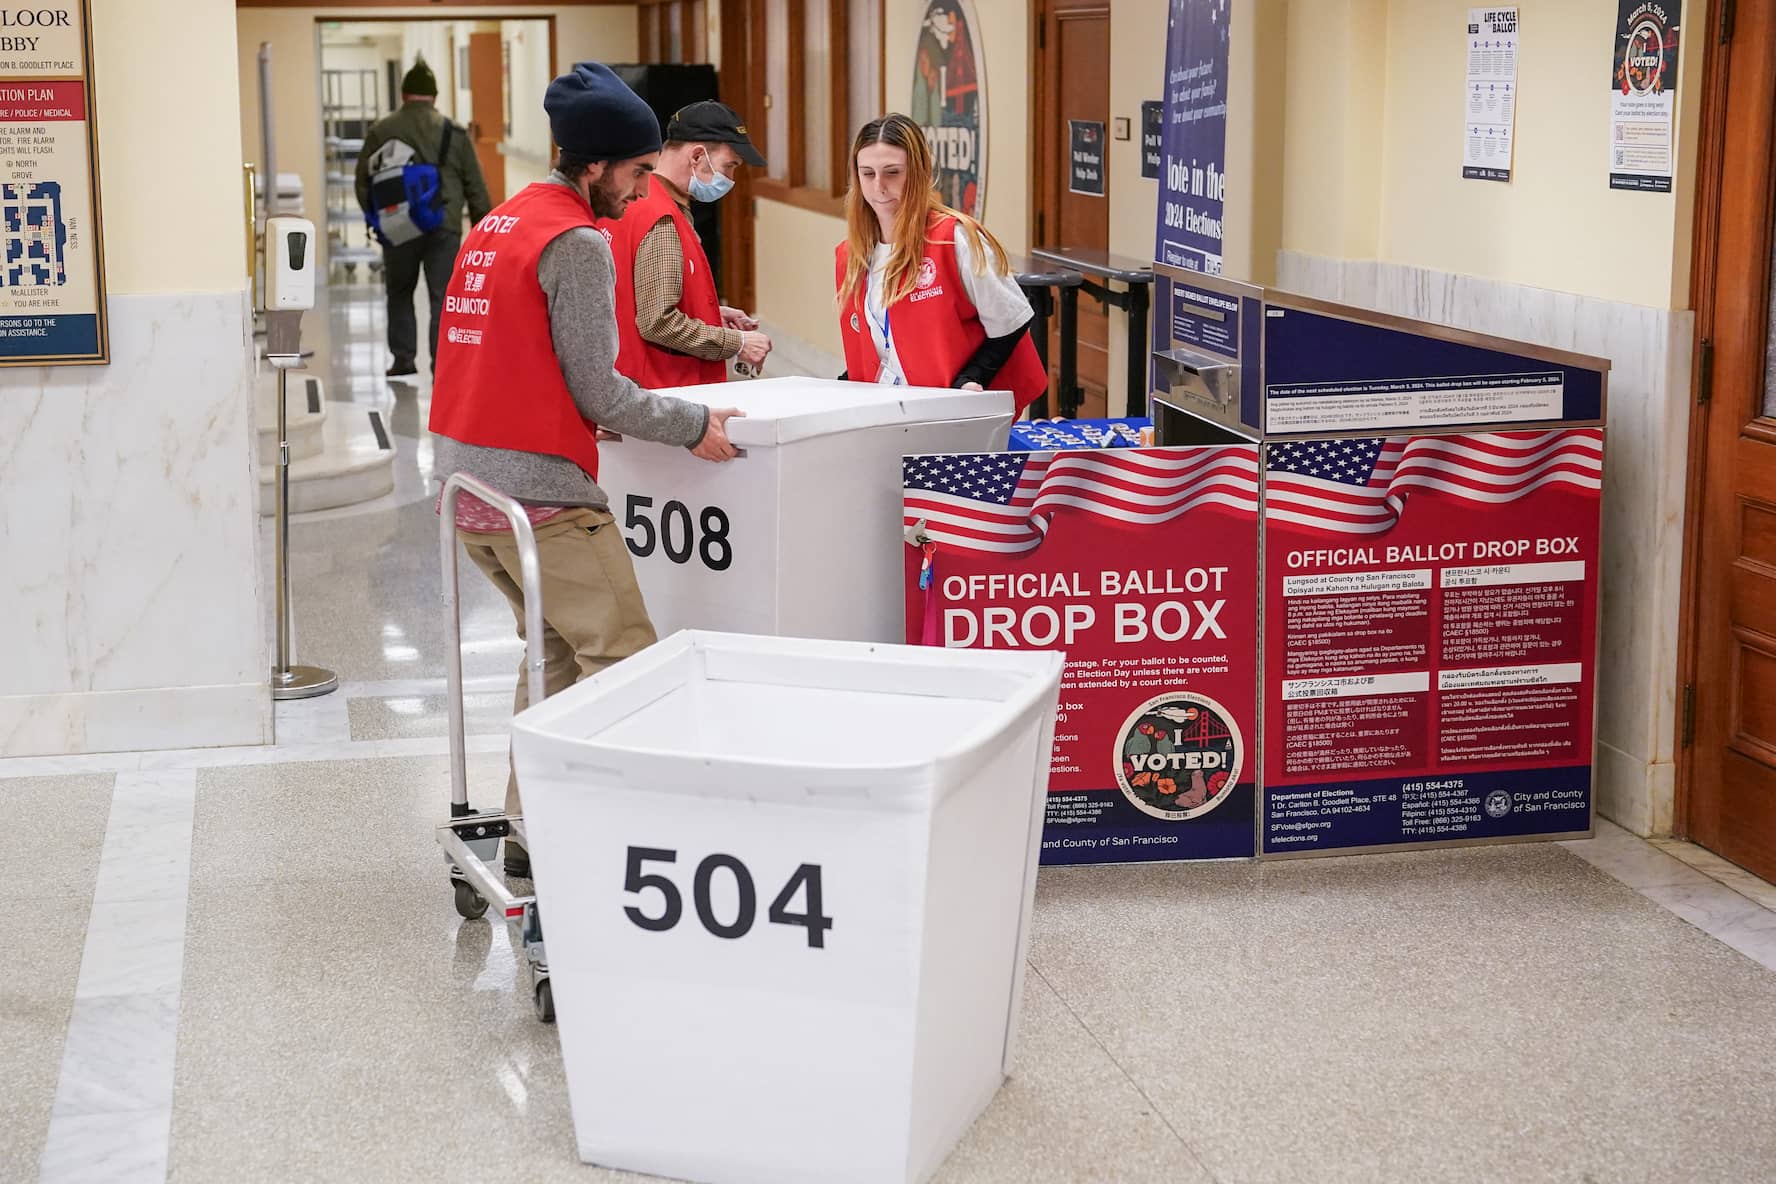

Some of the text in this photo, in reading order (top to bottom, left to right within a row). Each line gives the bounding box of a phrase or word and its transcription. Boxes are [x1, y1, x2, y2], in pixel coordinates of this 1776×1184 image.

[1484, 11, 1516, 22] LIFE CYCLE
[1492, 23, 1516, 33] BALLOT
[19, 61, 74, 70] GOODLETT PLACE
[1630, 56, 1658, 67] VOTED!
[28, 89, 54, 101] PLAN
[15, 109, 39, 118] POLICE
[44, 108, 72, 117] MEDICAL
[33, 127, 46, 135] AND
[922, 126, 976, 174] OTED!
[1167, 154, 1225, 202] Vote in the
[44, 319, 57, 327] THE
[625, 494, 733, 571] 508
[1286, 537, 1579, 568] OFFICIAL BALLOT DROP BOX
[942, 567, 1229, 601] OFFICIAL BALLOT
[1287, 577, 1319, 585] Lungsod
[1328, 576, 1354, 584] County
[944, 600, 1227, 649] DROP BOX
[1102, 659, 1117, 667] For
[1119, 660, 1139, 668] your
[1141, 657, 1165, 665] ballot
[1167, 657, 1176, 665] to
[1179, 656, 1190, 664] be
[1192, 655, 1229, 664] counted,
[1077, 670, 1111, 678] Election
[1114, 669, 1131, 679] Day
[1133, 667, 1161, 676] unless
[1163, 667, 1184, 675] there
[1202, 665, 1229, 673] voters
[1078, 680, 1117, 688] extended
[1119, 680, 1130, 689] by
[1139, 679, 1162, 687] court
[1164, 678, 1188, 686] order.
[1066, 702, 1084, 710] box
[1173, 729, 1183, 746] I
[1130, 752, 1227, 772] VOTED!
[1402, 780, 1464, 793] (415) 554-4375
[1271, 793, 1312, 801] Department
[1420, 792, 1438, 800] (415)
[1513, 790, 1583, 803] City and County
[1431, 800, 1449, 808] (415)
[1513, 801, 1586, 813] of San Francisco
[1428, 809, 1446, 817] (415)
[1271, 821, 1332, 831] SFVote@sfgov.org
[1402, 827, 1436, 835] TTY: (415)
[1043, 835, 1179, 849] and County of San Francisco
[1271, 834, 1318, 844] sfelections.org
[623, 845, 834, 949] 504
